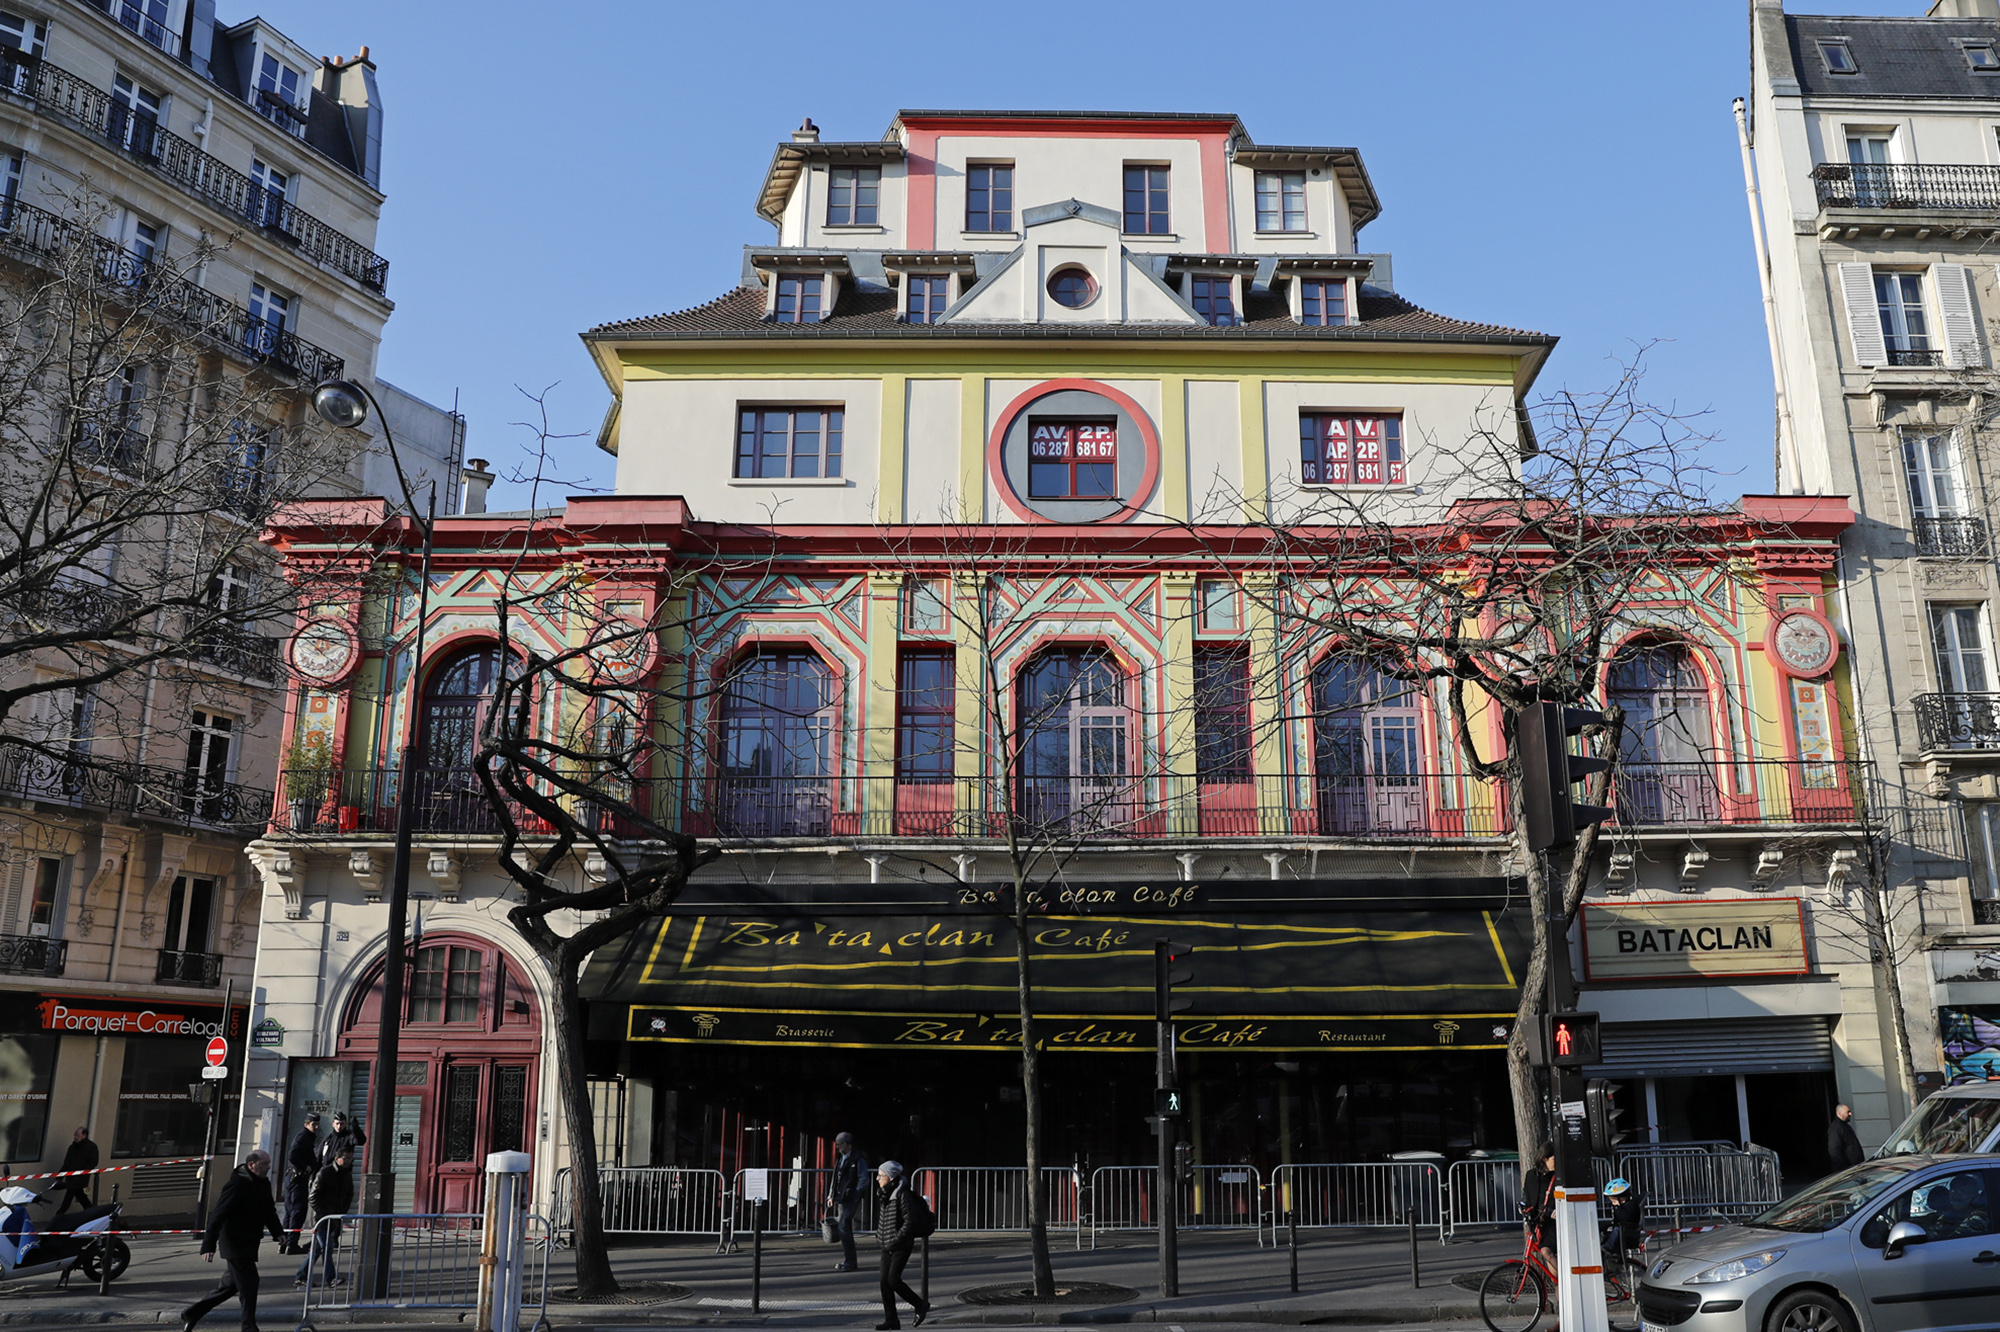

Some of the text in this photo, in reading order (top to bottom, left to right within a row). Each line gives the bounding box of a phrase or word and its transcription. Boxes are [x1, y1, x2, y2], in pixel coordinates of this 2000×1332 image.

[1034, 426, 1067, 439] AV.
[1032, 441, 1046, 456] 06
[1099, 441, 1114, 456] 67
[1325, 441, 1347, 459] AP.
[1303, 463, 1402, 480] 06 287 681 67
[1133, 885, 1199, 908] Café
[1035, 928, 1131, 951] Café
[1617, 926, 1772, 953] BATACLAN
[775, 1024, 835, 1037] Brasserie
[1179, 1022, 1268, 1047] Café
[1318, 1029, 1387, 1042] Restaurant
